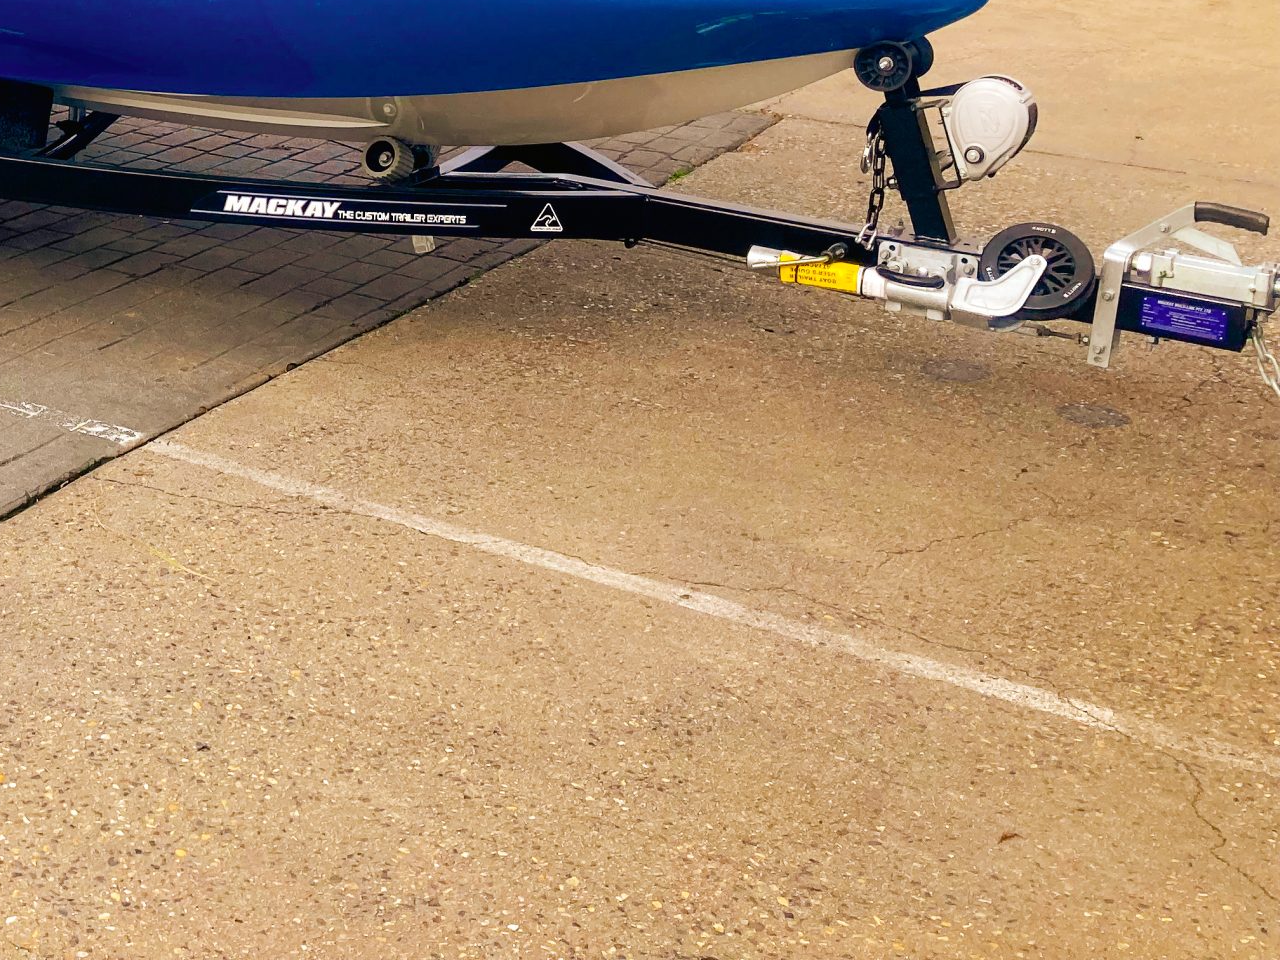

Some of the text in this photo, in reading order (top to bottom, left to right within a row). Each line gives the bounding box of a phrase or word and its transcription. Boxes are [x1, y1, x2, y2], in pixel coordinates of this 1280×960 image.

[223, 194, 467, 224] MACKAY THE CUSTOM TRAILER EXPERTS
[789, 273, 817, 282] TRAILR
